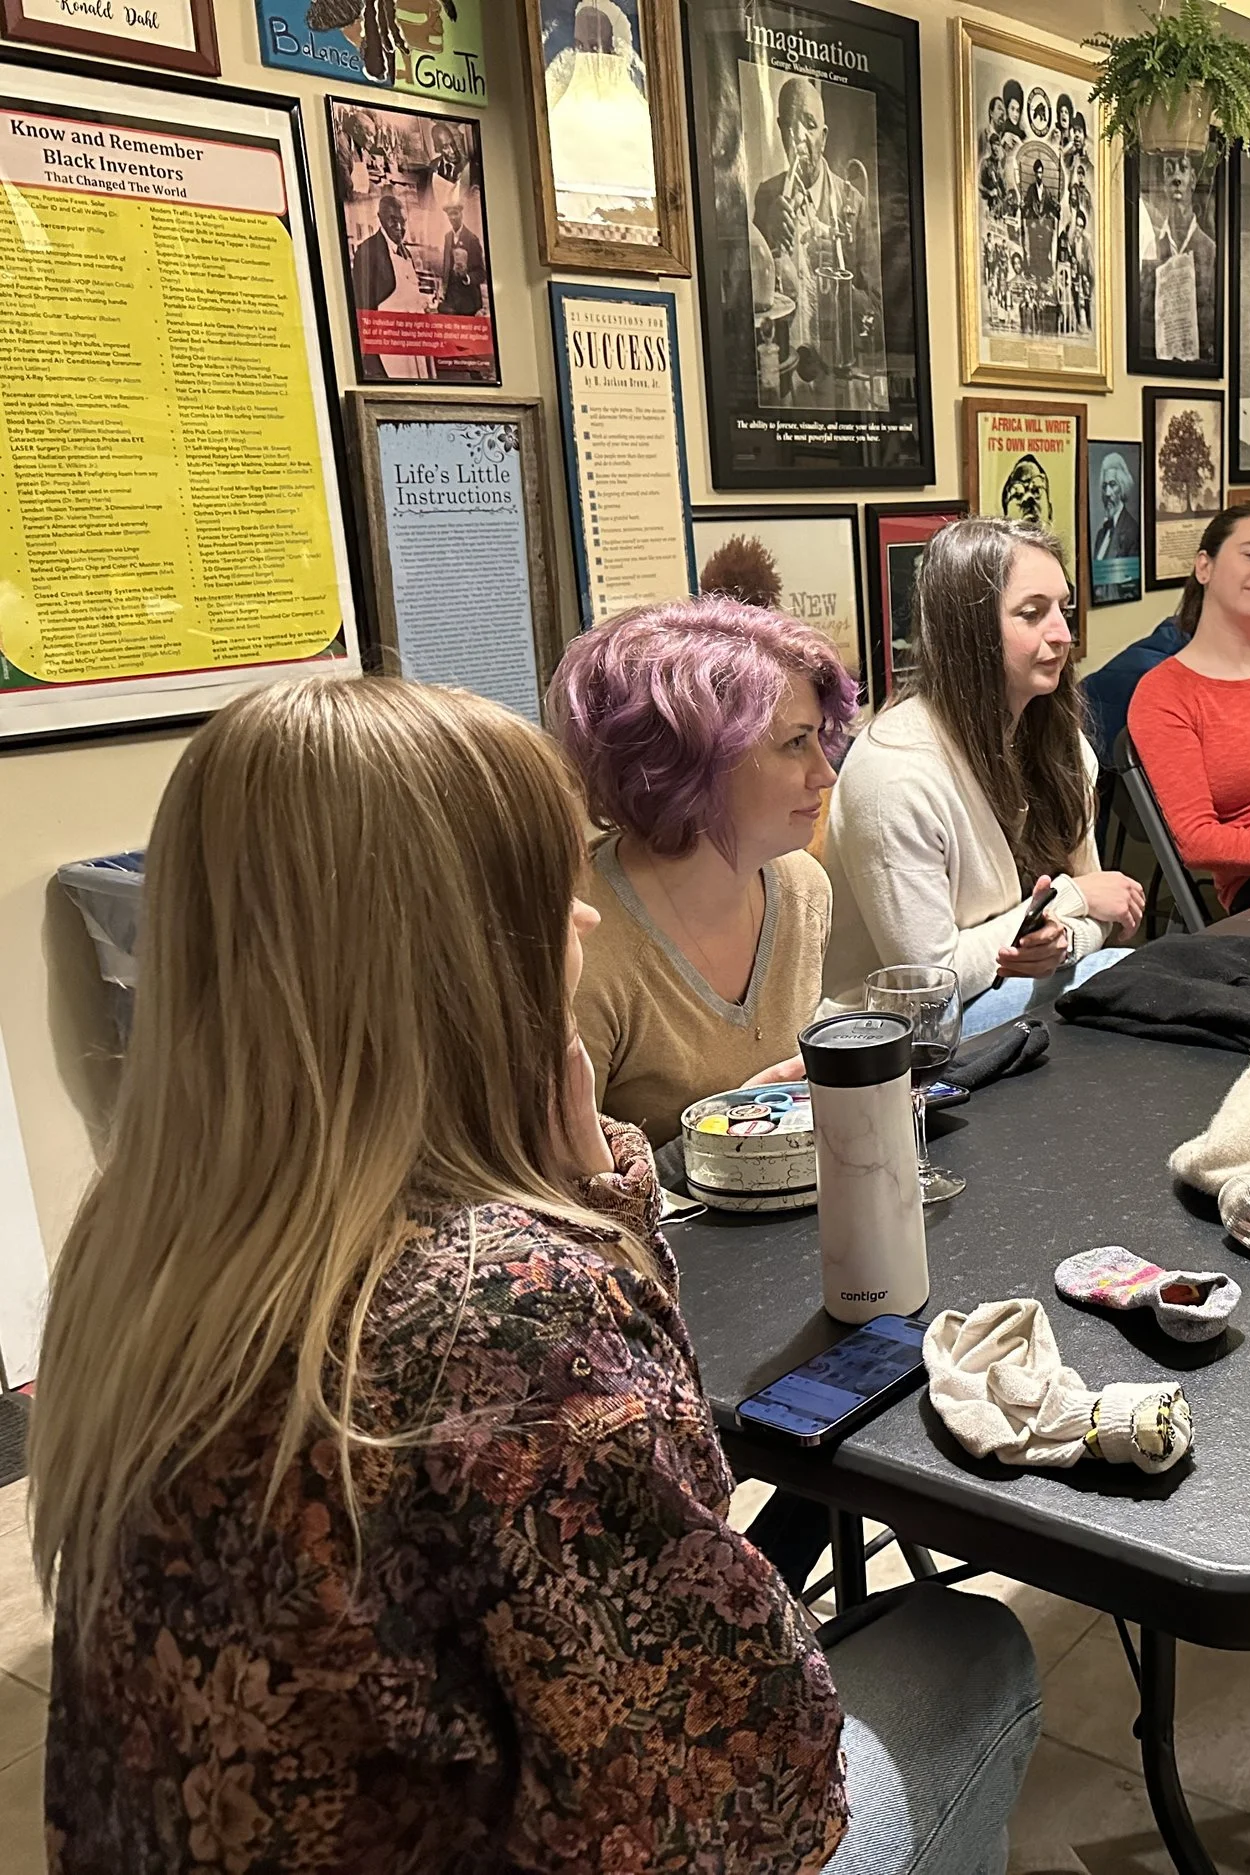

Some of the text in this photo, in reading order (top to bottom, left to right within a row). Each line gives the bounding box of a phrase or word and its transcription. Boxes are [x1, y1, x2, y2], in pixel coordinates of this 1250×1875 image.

[124, 6, 160, 29] Dahl
[745, 16, 870, 73] Imagination
[10, 119, 204, 160] Know and Remember
[43, 148, 184, 181] Black Inventors
[44, 171, 187, 198] That Changed The World
[585, 313, 643, 325] SUGGESTIONS
[648, 318, 664, 328] FOR
[573, 330, 666, 372] SUCCESS
[992, 417, 1071, 434] AFRICA WILL WRITE
[988, 438, 1064, 452] IT'S OWN HISTORY!
[394, 464, 510, 484] Life's Little
[396, 486, 512, 505] Instructions
[85, 589, 112, 597] Security
[789, 591, 836, 618] NEW
[841, 1291, 886, 1302] contigo
